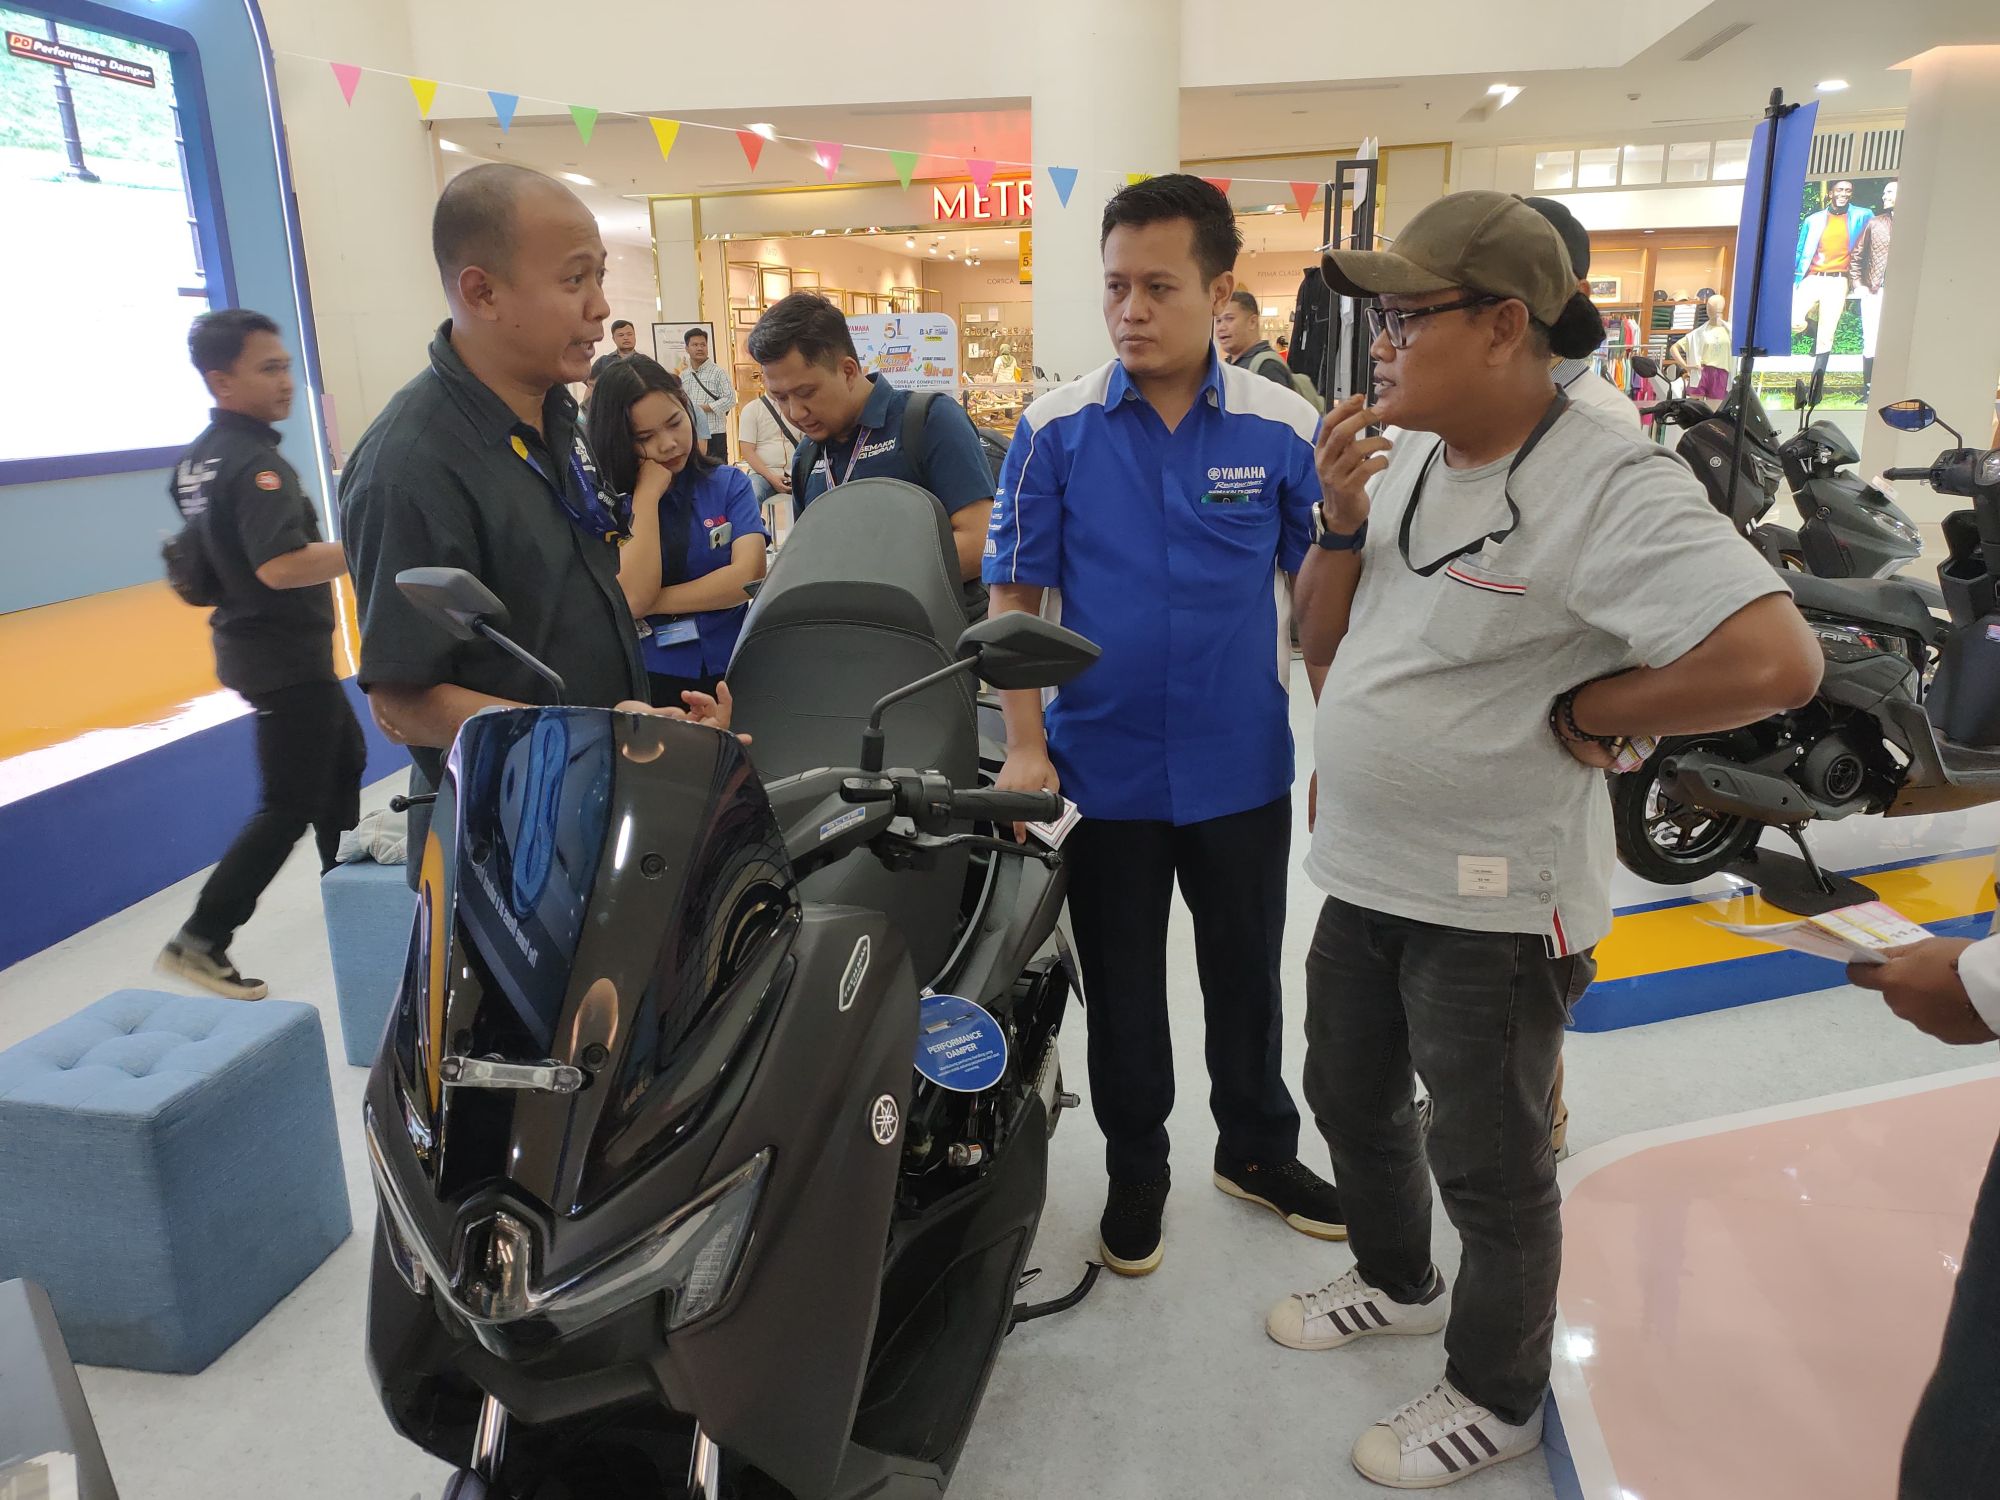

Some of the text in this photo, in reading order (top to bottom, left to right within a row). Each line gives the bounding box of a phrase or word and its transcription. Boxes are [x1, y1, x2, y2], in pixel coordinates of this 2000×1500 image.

[13, 35, 151, 77] PD Performance Damper
[860, 437, 897, 453] SEMAKIN
[1221, 466, 1266, 480] YAMAHA
[926, 1030, 984, 1055] PERFORMANCE
[945, 1042, 978, 1059] DAMPER
